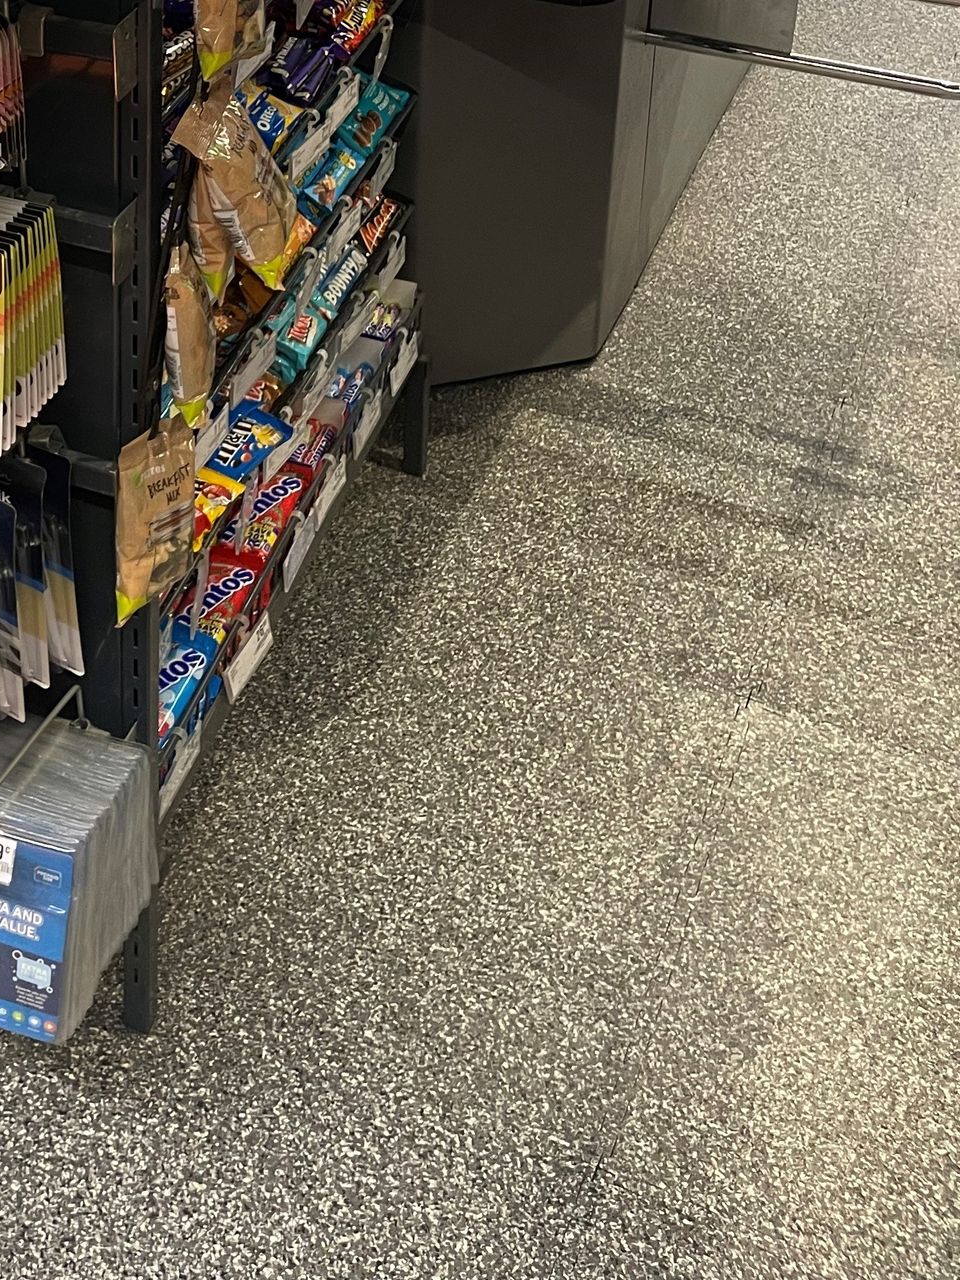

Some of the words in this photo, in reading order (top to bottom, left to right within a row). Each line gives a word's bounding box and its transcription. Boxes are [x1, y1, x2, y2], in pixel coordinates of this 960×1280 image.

[324, 260, 357, 305] BOUNTY
[147, 462, 191, 499] BREAKFAST
[166, 487, 181, 506] MIX
[12, 904, 43, 926] AND
